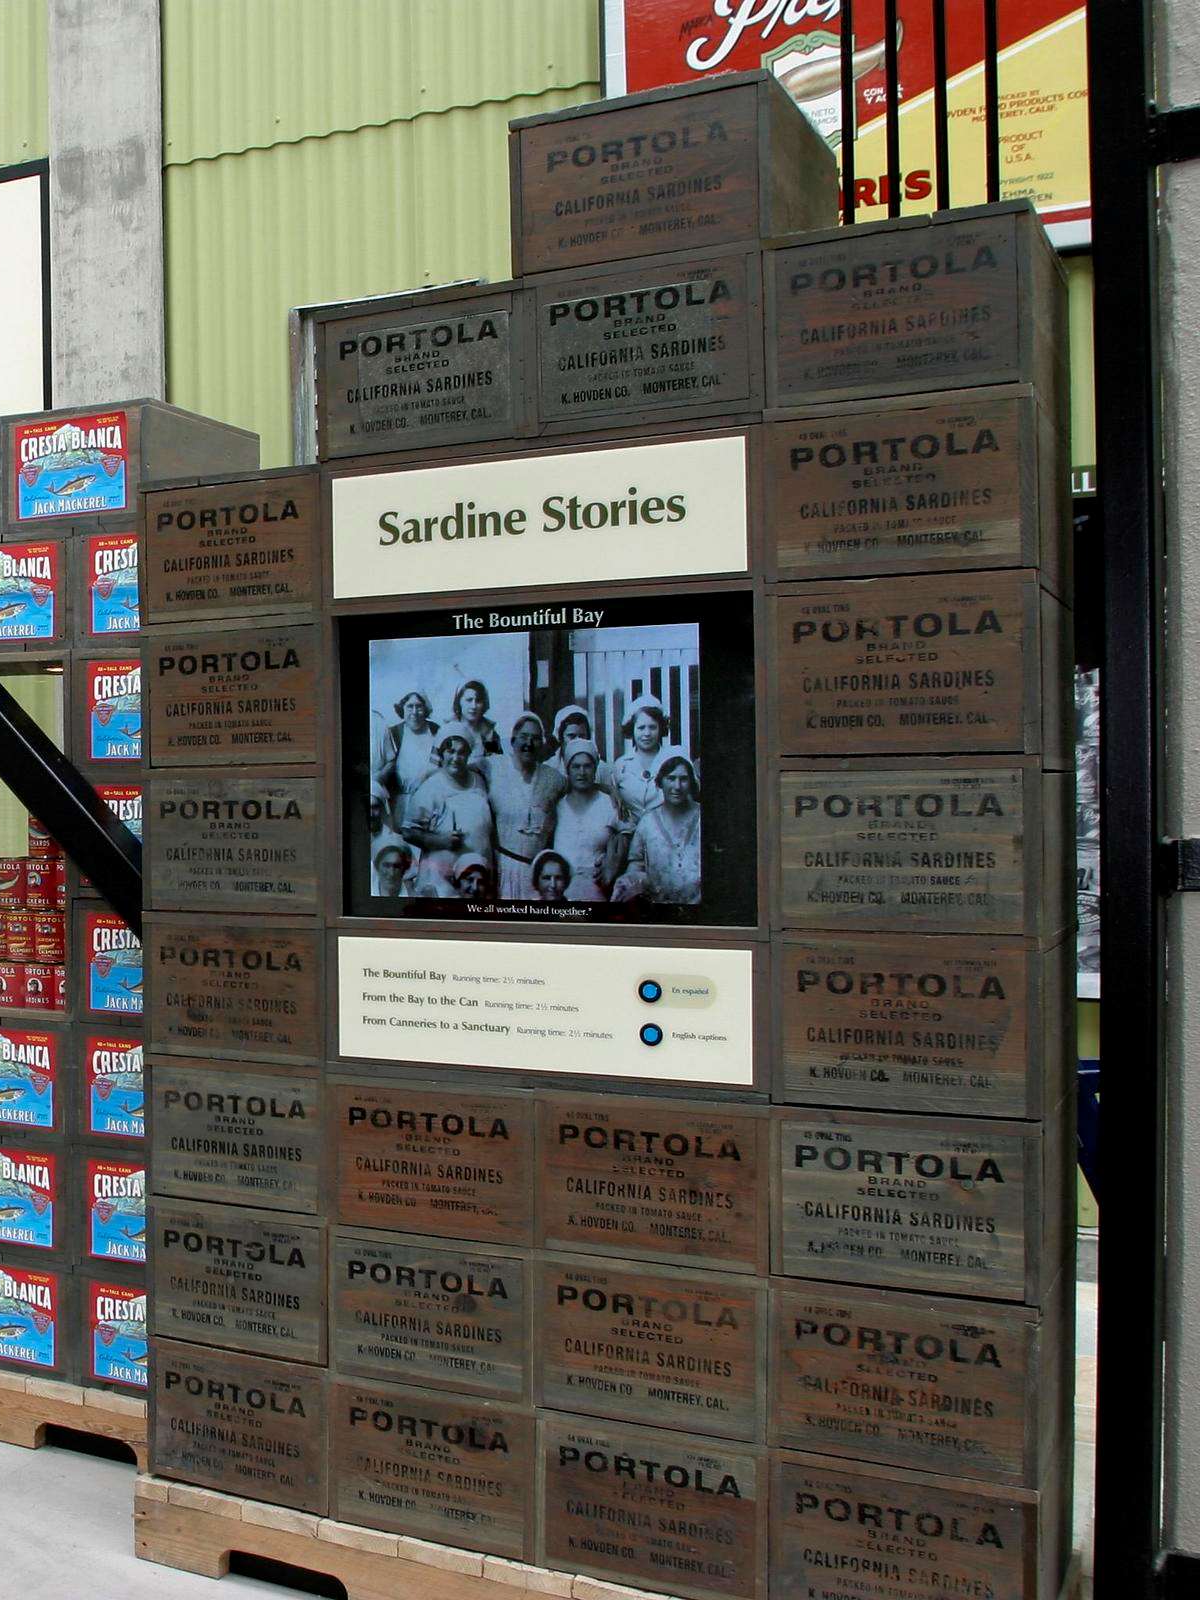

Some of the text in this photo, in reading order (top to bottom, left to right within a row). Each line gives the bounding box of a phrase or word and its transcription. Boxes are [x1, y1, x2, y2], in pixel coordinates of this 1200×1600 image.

[1009, 94, 1064, 109] PRODUCTS
[547, 120, 728, 174] PORTOLA
[998, 130, 1044, 143] PRODUCT
[791, 246, 998, 296] PORTOLA
[550, 280, 730, 326] PORTOLA
[603, 322, 676, 340] SELECTED
[614, 313, 665, 328] BRAND
[339, 318, 498, 361] PORTOLA
[558, 335, 726, 371] CALIFORNIA SARDINES
[347, 371, 493, 404] CALIFORNIA SARDINES
[20, 425, 123, 462] CRESTA BLANCA
[789, 428, 999, 472] PORTOLA
[32, 492, 107, 515] JACK MACKEREL
[157, 501, 299, 532] PORTOLA
[379, 487, 687, 547] Sardine Stories
[3, 551, 51, 580] BLANCA
[163, 548, 294, 573] CALIFORNIA SARDINES
[452, 608, 604, 630] The Bountiful Bay
[792, 609, 1003, 645] PORTOLA
[159, 649, 300, 676] PORTOLA
[803, 669, 995, 694] CALIFORNIA SARDINES
[160, 800, 302, 820] PORTOLA
[795, 793, 1005, 818] PORTOLA
[466, 904, 482, 913] We
[484, 904, 494, 913] all
[496, 904, 528, 914] worked
[529, 905, 549, 915] hard
[160, 946, 303, 971] PORTOLA
[362, 968, 380, 979] The
[383, 969, 427, 980] Bountiful
[429, 971, 447, 982] Bay
[452, 974, 481, 985] Running
[516, 977, 545, 986] minutes
[796, 970, 1006, 1000] PORTOLA
[362, 992, 386, 1003] From
[389, 993, 405, 1003] the
[407, 994, 425, 1006] Bay
[427, 996, 438, 1005] to
[440, 996, 456, 1006] the
[459, 997, 479, 1007] Can
[484, 1000, 514, 1010] Running
[549, 1004, 579, 1013] minutes
[362, 1015, 386, 1026] From
[389, 1017, 437, 1029] Canneries
[440, 1021, 450, 1030] to
[462, 1022, 511, 1036] Sanctuary
[516, 1026, 546, 1037] Running
[583, 1030, 614, 1040] minutes
[671, 1031, 728, 1042] English captions
[3, 1042, 50, 1070] BLANCA
[164, 1090, 306, 1119] PORTOLA
[348, 1106, 510, 1140] PORTOLA
[171, 1136, 302, 1162] CALIFORNIA SARDINES
[559, 1123, 741, 1162] PORTOLA
[3, 1160, 50, 1190] BLANCA
[795, 1145, 1004, 1184] PORTOLA
[803, 1200, 995, 1234] CALIFORNIA SARDINES
[163, 1228, 306, 1269] PORTOLA
[4, 1277, 51, 1310] BLANCA
[347, 1259, 509, 1300] PORTOLA
[557, 1285, 739, 1330] PORTOLA
[610, 1326, 684, 1345] SELECTED
[795, 1318, 1002, 1368] PORTOLA
[565, 1337, 732, 1378] CALIFORNIA SARDINES
[165, 1370, 306, 1418] PORTOLA
[349, 1406, 510, 1454] PORTOLA
[559, 1445, 742, 1499] PORTOLA
[795, 1492, 1004, 1550] PORTOLA
